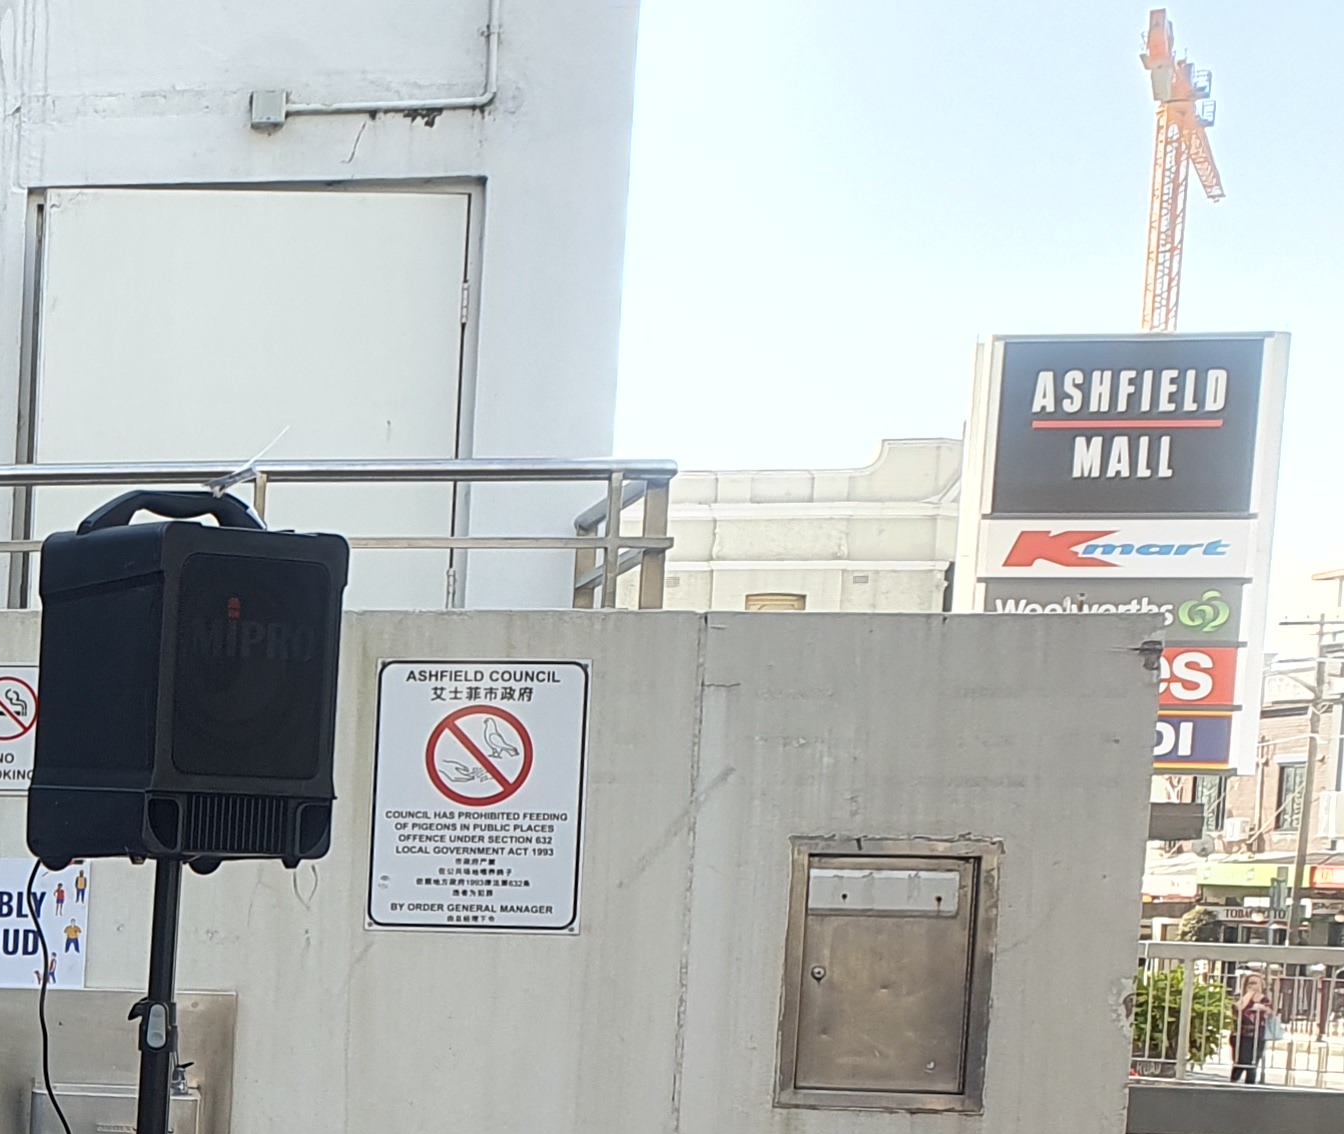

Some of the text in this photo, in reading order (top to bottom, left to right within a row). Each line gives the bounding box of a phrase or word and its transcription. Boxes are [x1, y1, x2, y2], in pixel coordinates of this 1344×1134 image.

[1032, 369, 1229, 414] ASHFIELD
[1072, 435, 1174, 479] MALL
[1002, 529, 1231, 567] Kmart
[406, 670, 561, 683] ASHFIELD COUNCIL
[431, 686, 533, 702] 艾士菲市政府
[386, 811, 567, 821] COUNCIL HAS PROHIBITED FEEDING
[395, 823, 554, 832] OF PIGEONS IN PUBLIC PLACES
[398, 834, 552, 844] OFFENCE UNDER SECTION 632
[396, 846, 554, 856] LOCAL GOVERNMENT ACT 1993
[390, 903, 553, 914] BY ORDER GENERAL MANAGER
